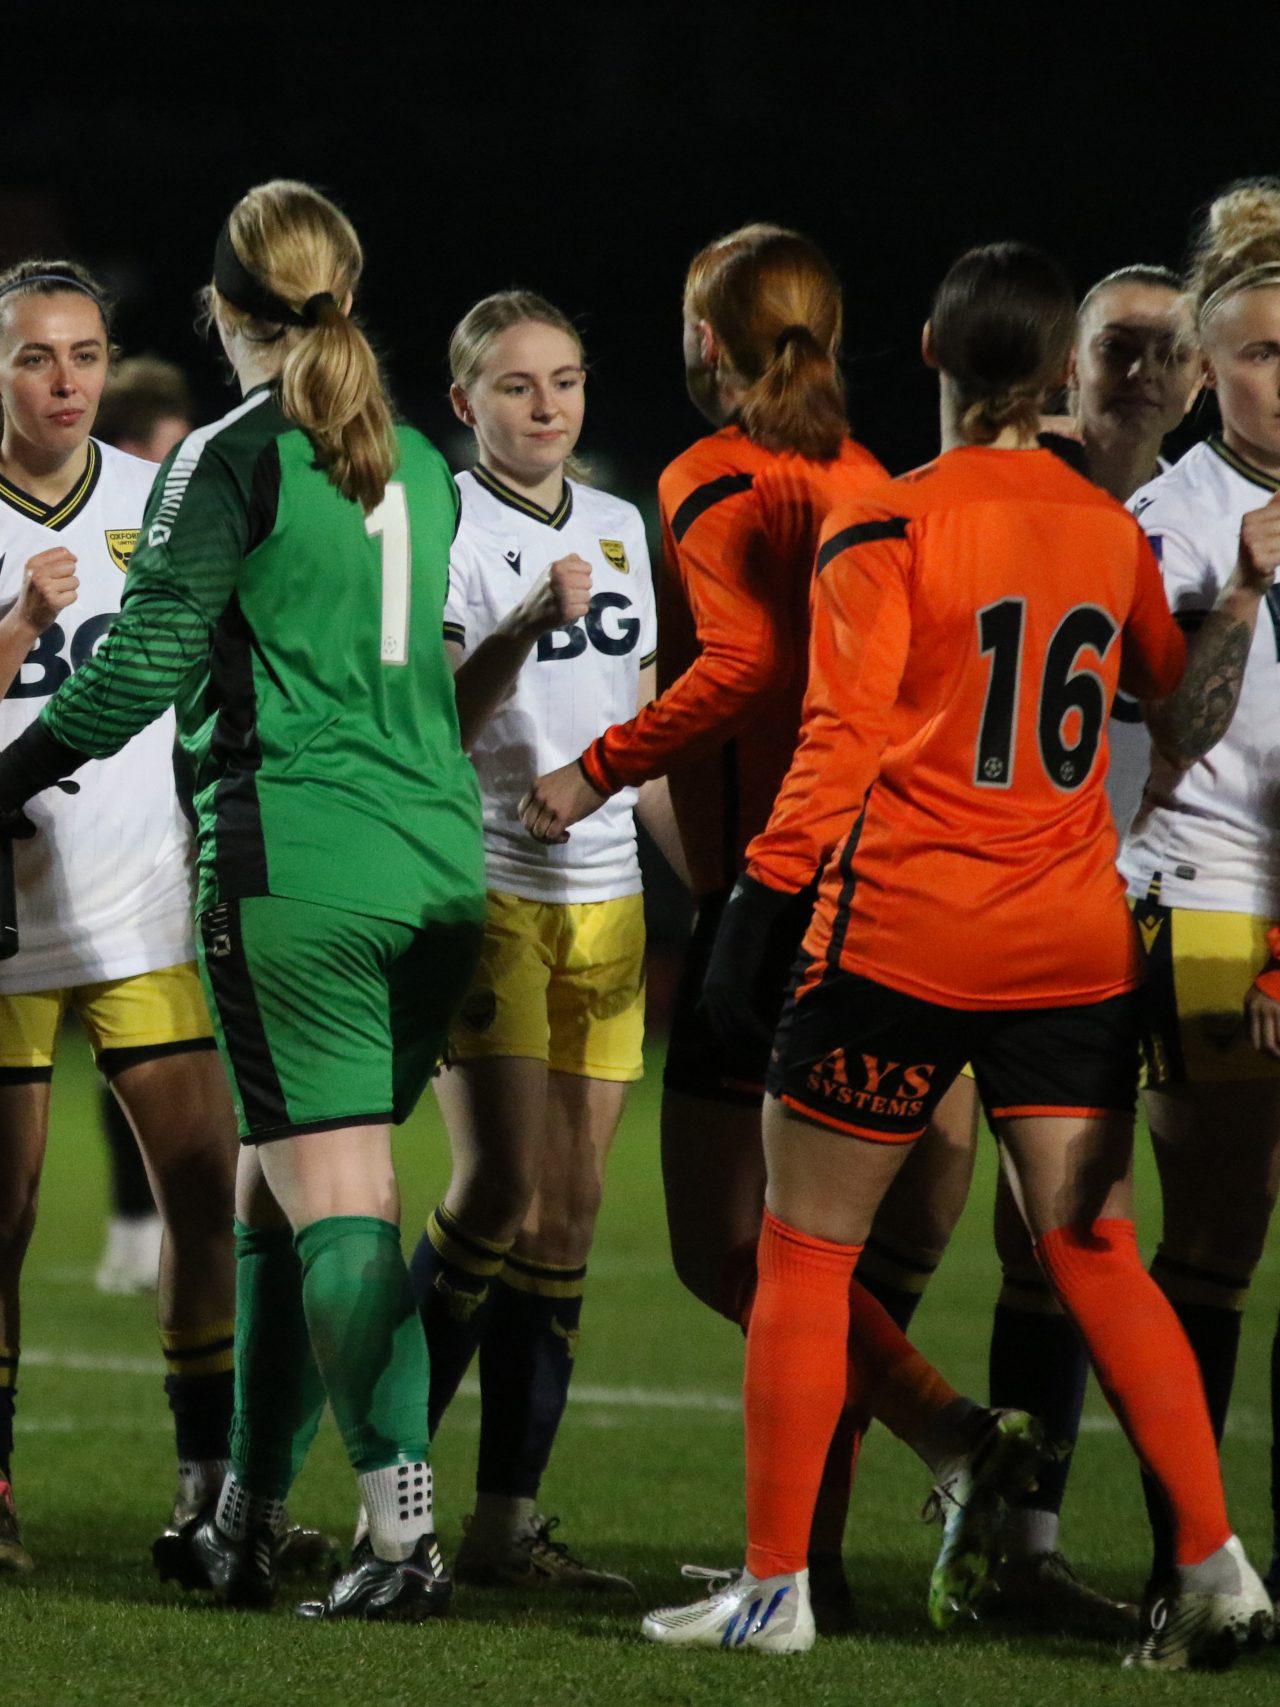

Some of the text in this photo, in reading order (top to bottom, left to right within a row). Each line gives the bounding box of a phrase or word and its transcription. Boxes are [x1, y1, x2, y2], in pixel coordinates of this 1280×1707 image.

[364, 482, 412, 665] 1
[973, 596, 1121, 791] 16
[807, 1073, 923, 1117] SYSTEMS
[813, 1048, 936, 1099] AYS
